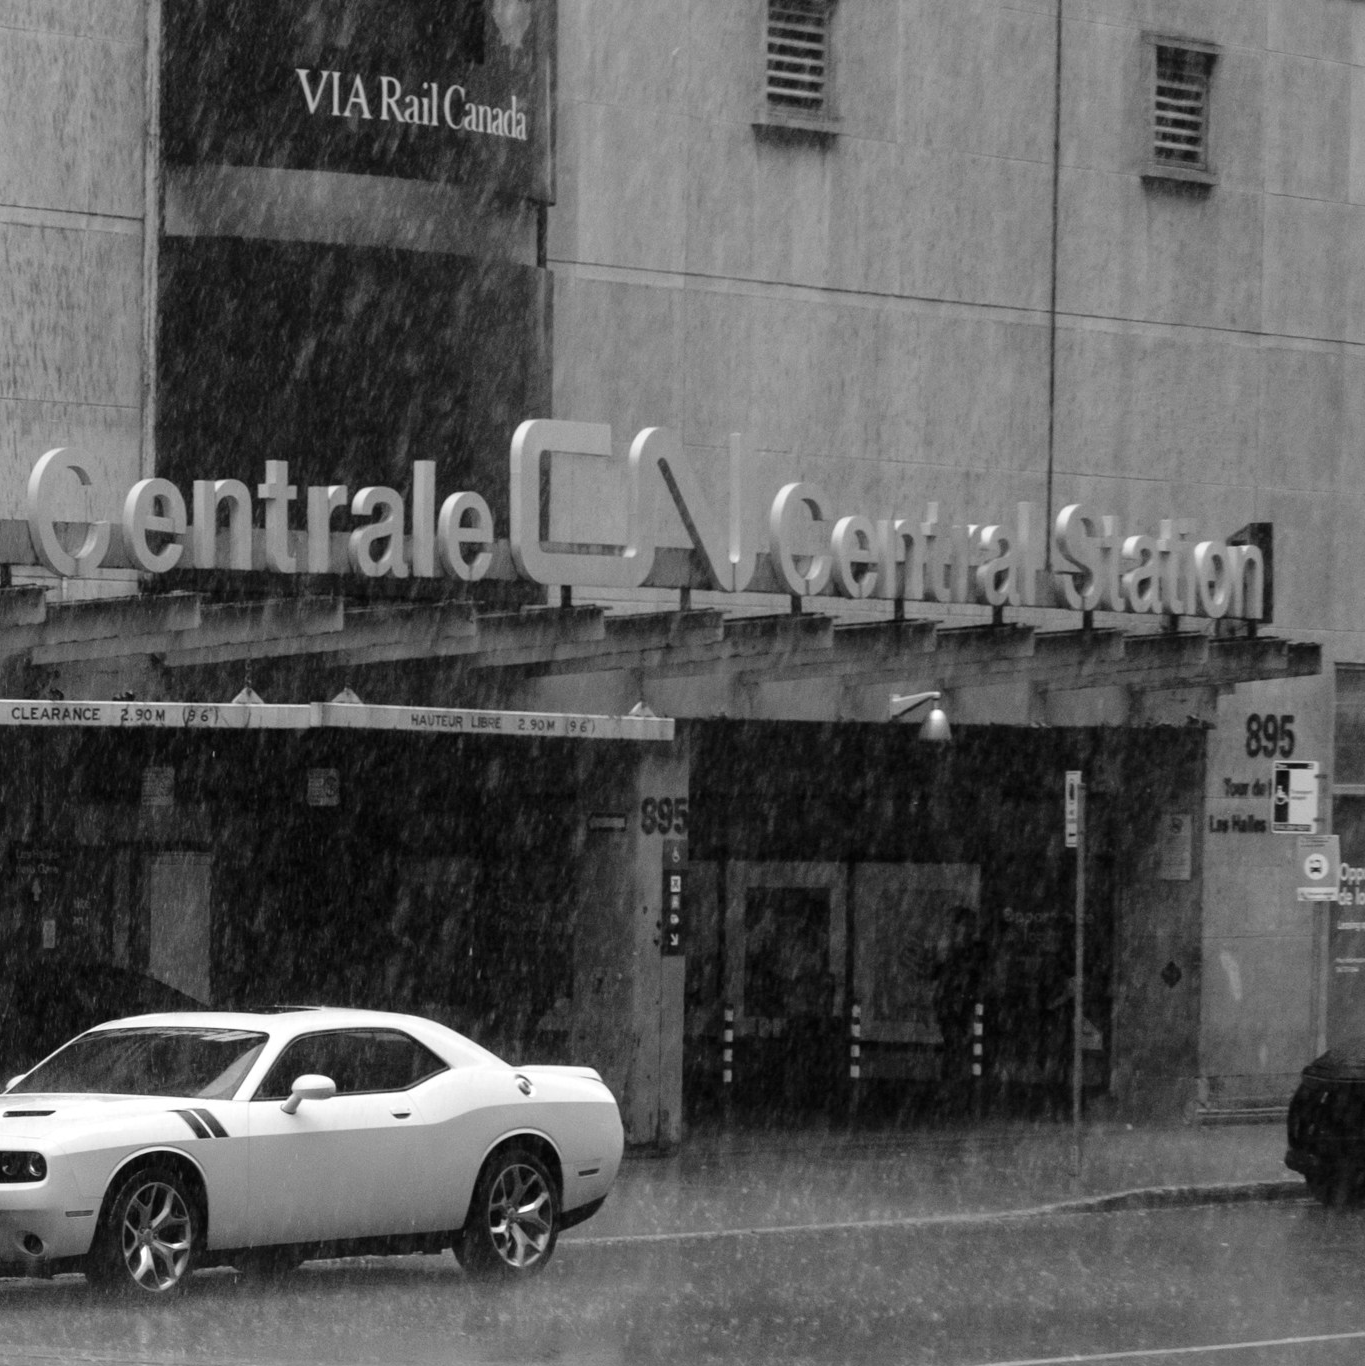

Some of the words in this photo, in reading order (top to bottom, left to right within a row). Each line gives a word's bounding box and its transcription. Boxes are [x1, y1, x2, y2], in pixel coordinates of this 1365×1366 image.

[295, 68, 374, 120] VIA
[380, 75, 440, 128] Rail
[444, 84, 527, 141] Canada
[28, 446, 494, 582] Centrale
[770, 481, 1037, 607] Central
[1055, 503, 1264, 620] Station
[11, 706, 101, 721] CLEARANCE
[411, 713, 463, 729] HAUTEUR
[471, 715, 502, 730] LIBRE
[1245, 713, 1295, 758] 895
[641, 797, 688, 835] 895
